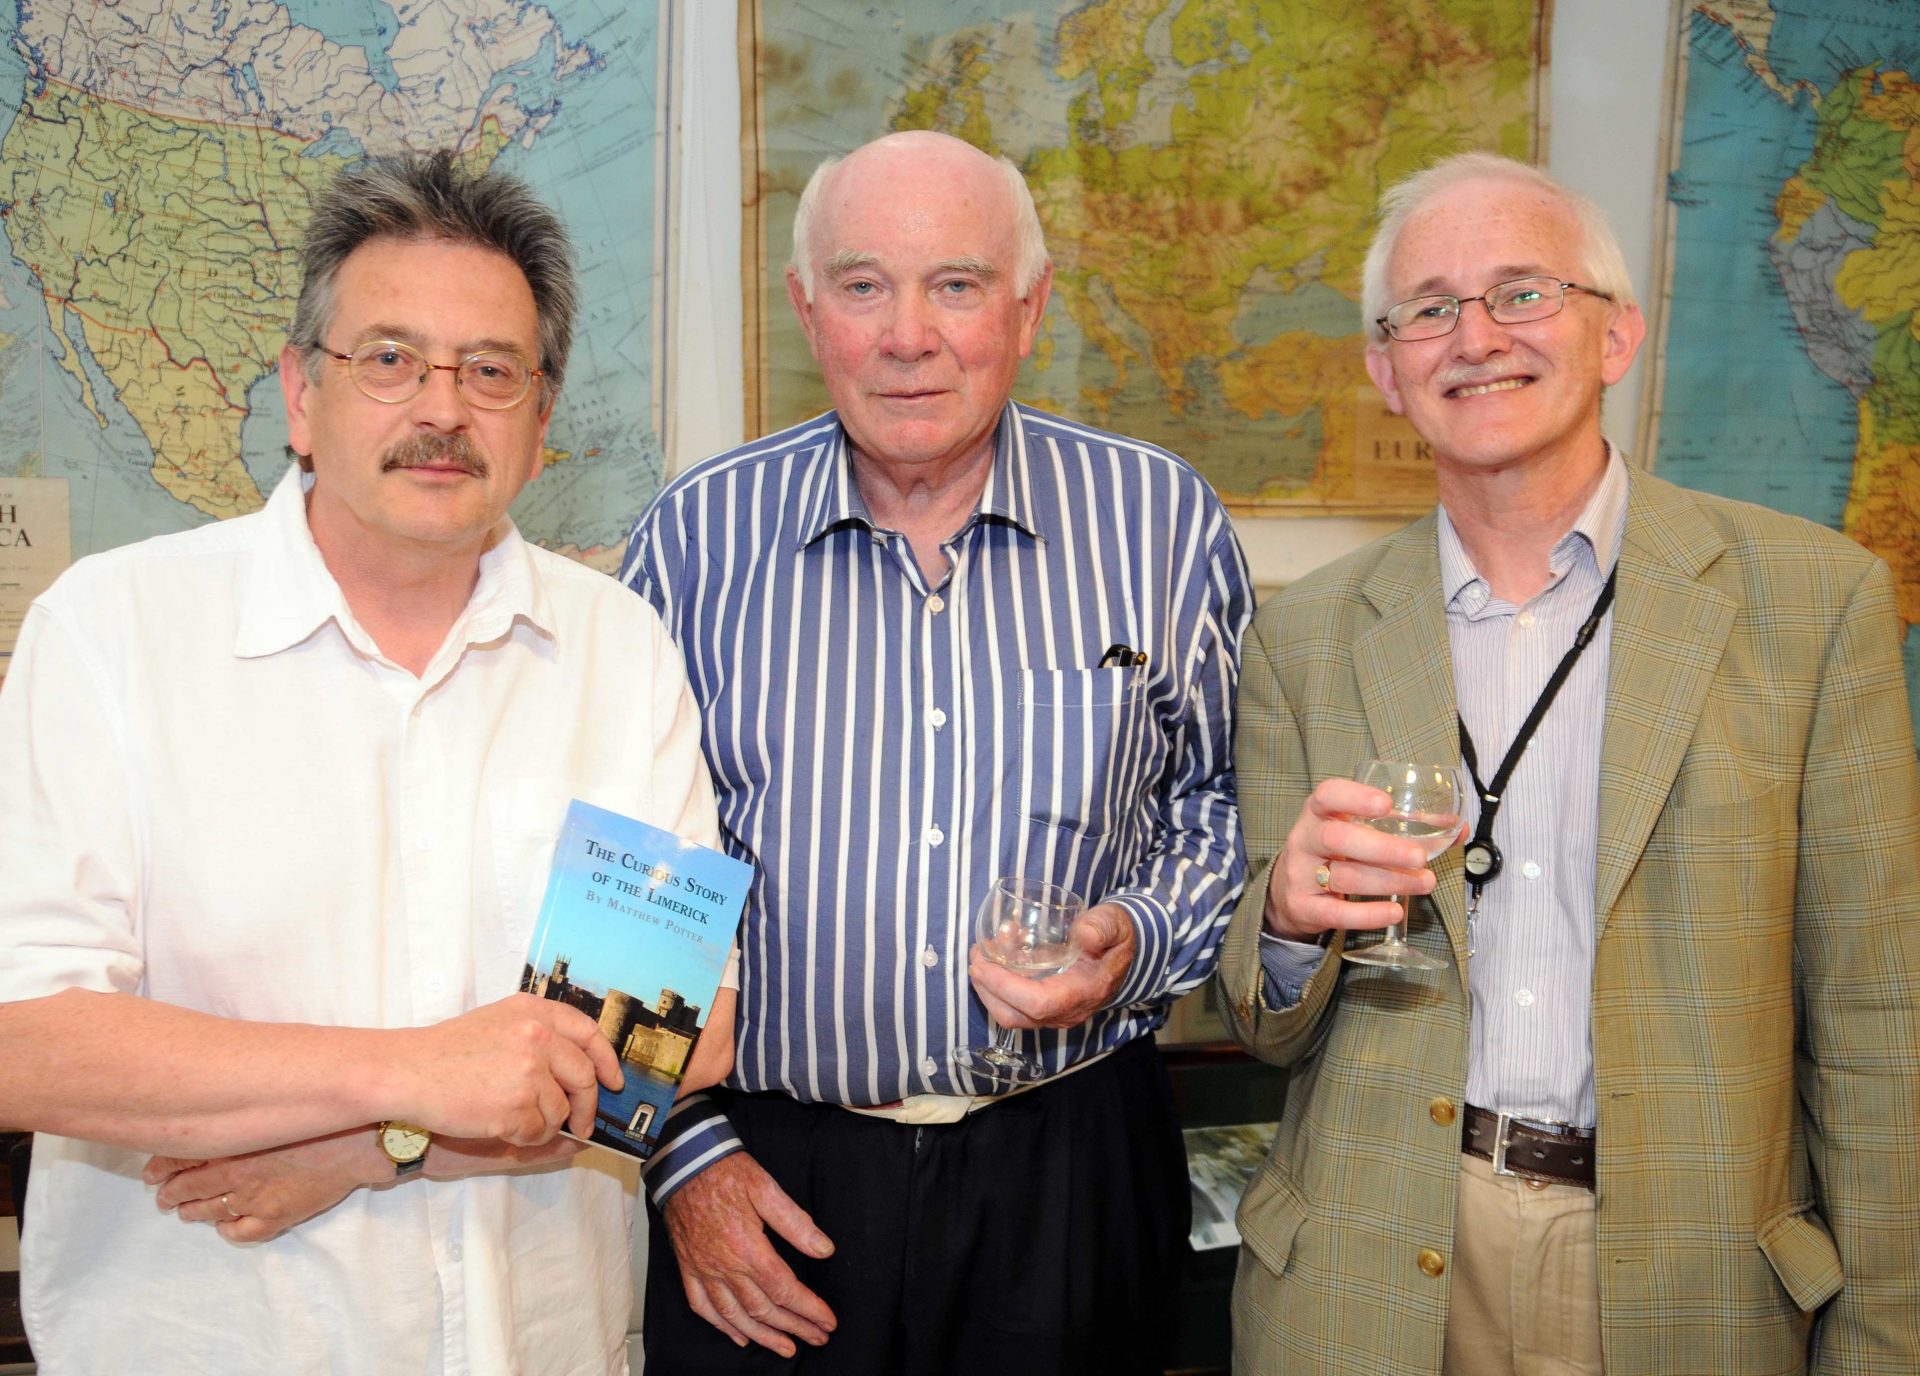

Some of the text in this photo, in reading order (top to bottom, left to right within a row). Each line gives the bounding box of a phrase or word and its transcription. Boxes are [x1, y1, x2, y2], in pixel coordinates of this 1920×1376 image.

[586, 839, 728, 907] THE CURIOUS STORY
[591, 871, 710, 925] OF THE LIMERICK
[606, 896, 661, 927] MATTHEW
[665, 918, 704, 945] POTTER
